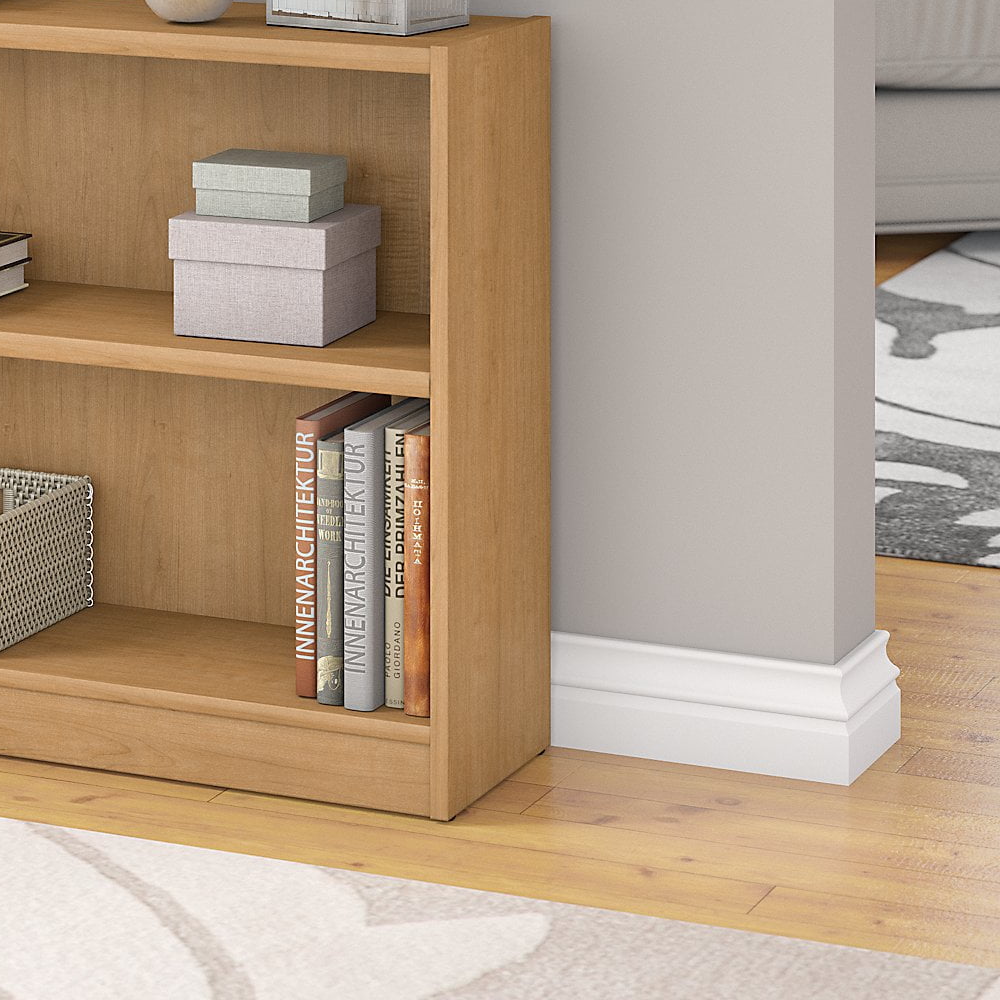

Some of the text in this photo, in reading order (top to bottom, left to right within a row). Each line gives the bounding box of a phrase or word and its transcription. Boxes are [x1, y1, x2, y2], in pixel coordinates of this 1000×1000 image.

[296, 432, 315, 660] INNENARCHITEKTUR
[318, 529, 342, 542] WORK
[344, 442, 366, 674] INNENARCHITEKTUR
[393, 621, 401, 679] GIORDANO
